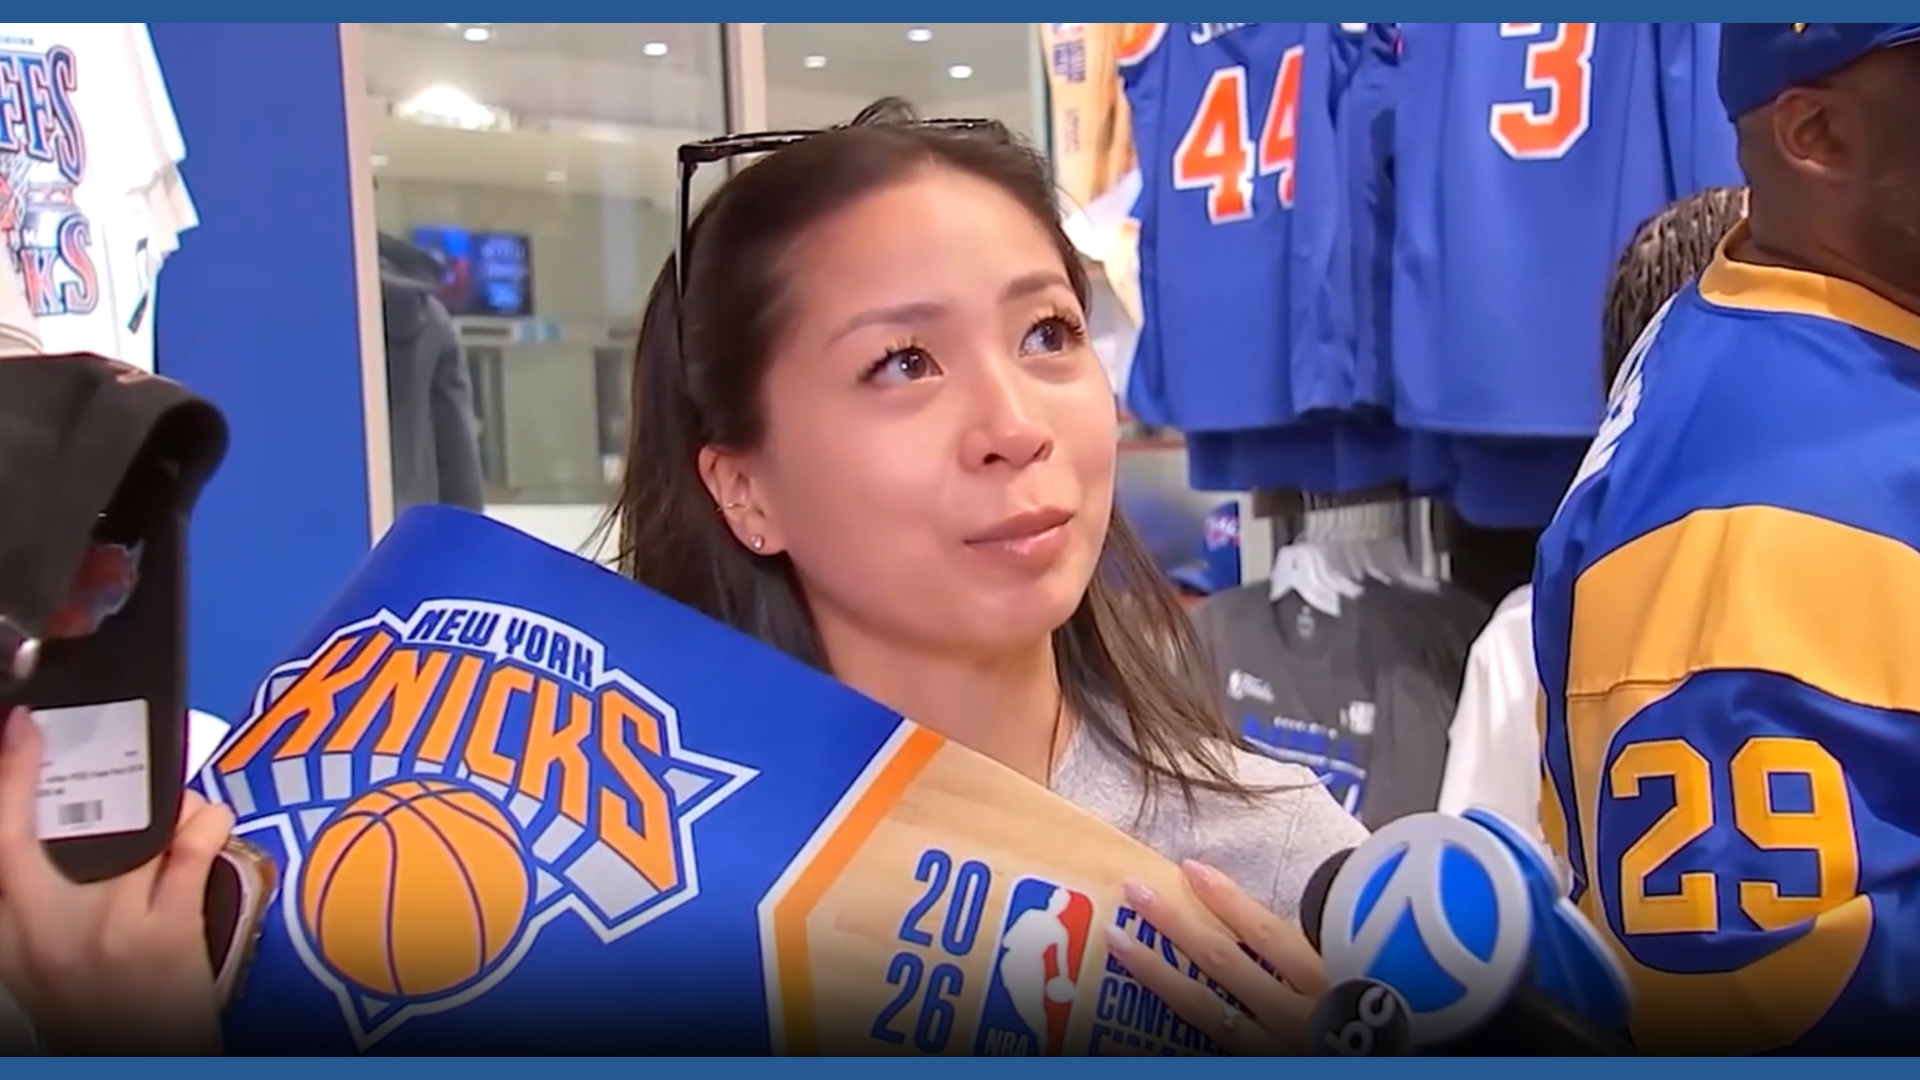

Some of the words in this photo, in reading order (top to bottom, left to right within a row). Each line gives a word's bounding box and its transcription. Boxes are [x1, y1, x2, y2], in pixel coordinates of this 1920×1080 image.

[1489, 23, 1597, 160] 3
[406, 607, 501, 647] NEW
[503, 615, 594, 688] YORK
[214, 628, 680, 895] KNICKS
[1609, 737, 1860, 934] 29
[898, 848, 992, 956] 20
[870, 951, 964, 1054] 26
[983, 1027, 1029, 1056] NBA
